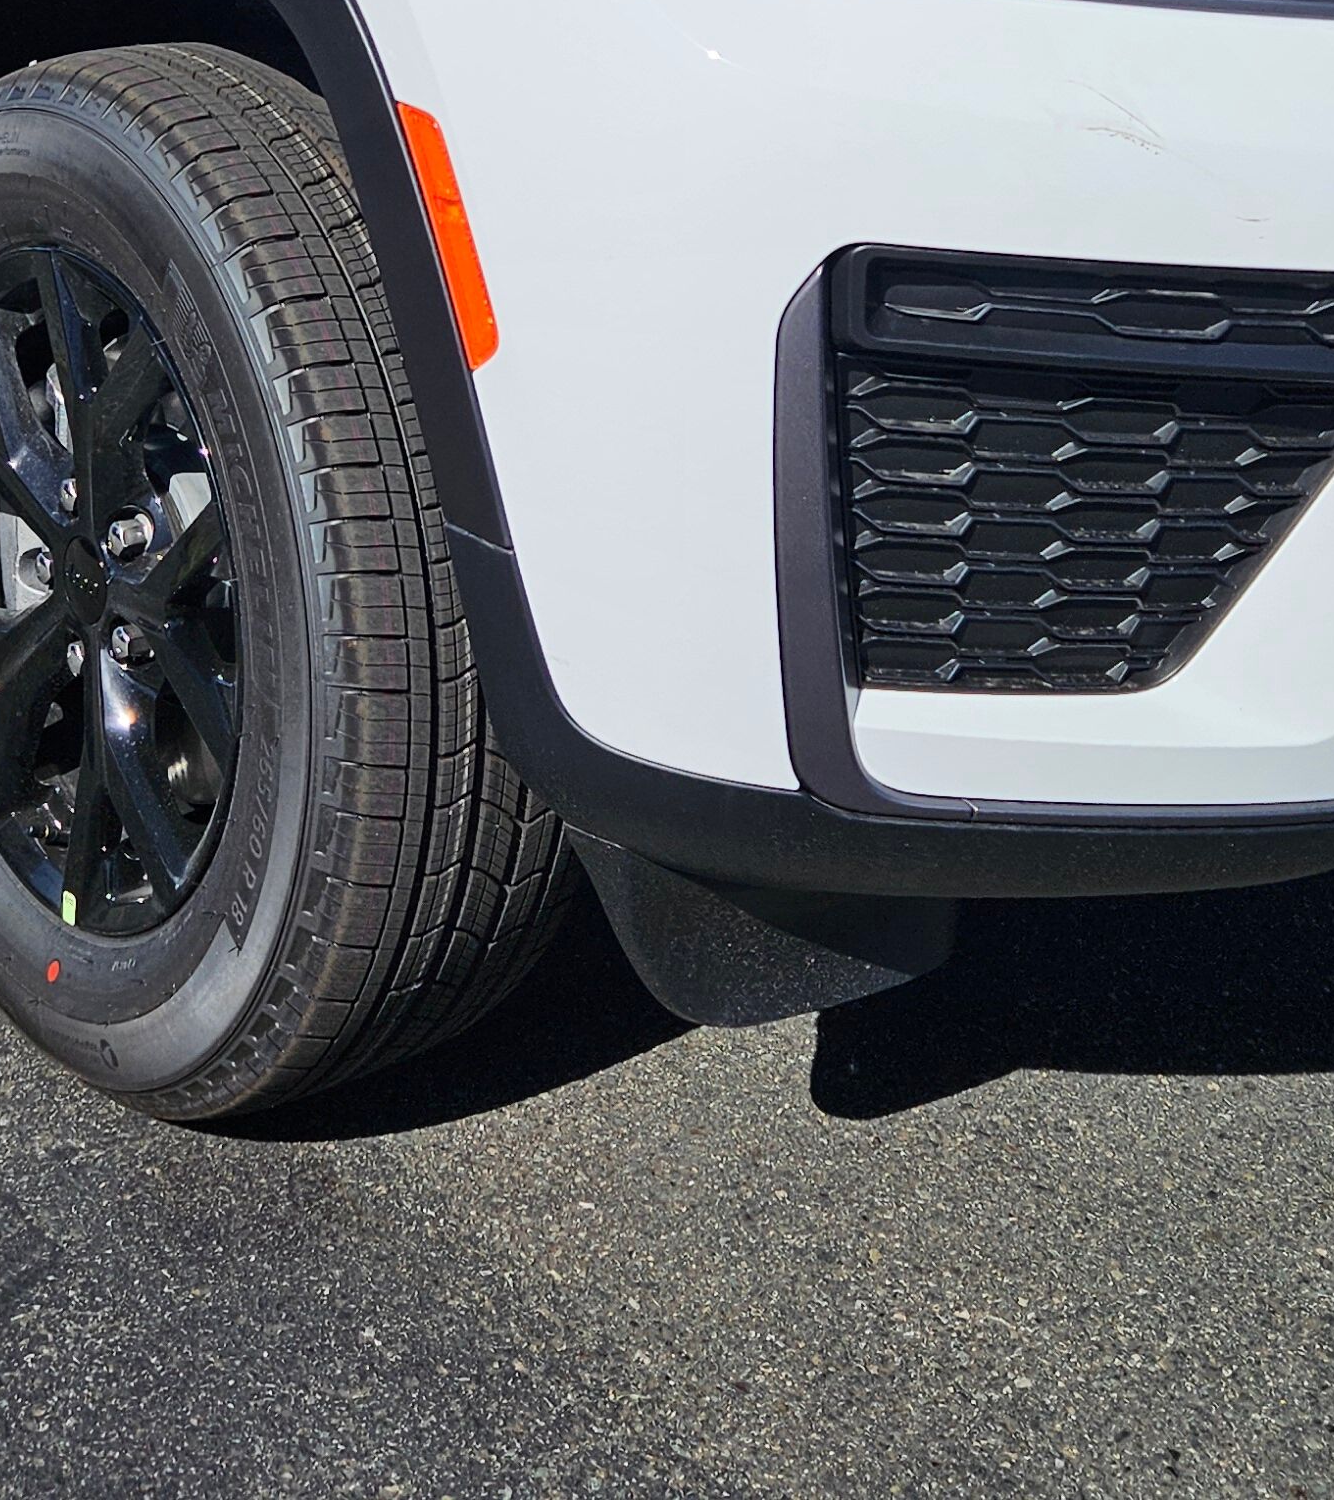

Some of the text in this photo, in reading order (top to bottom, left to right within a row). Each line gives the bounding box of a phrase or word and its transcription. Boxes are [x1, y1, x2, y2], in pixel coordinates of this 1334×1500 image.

[231, 737, 275, 927] 265/60 R 18
